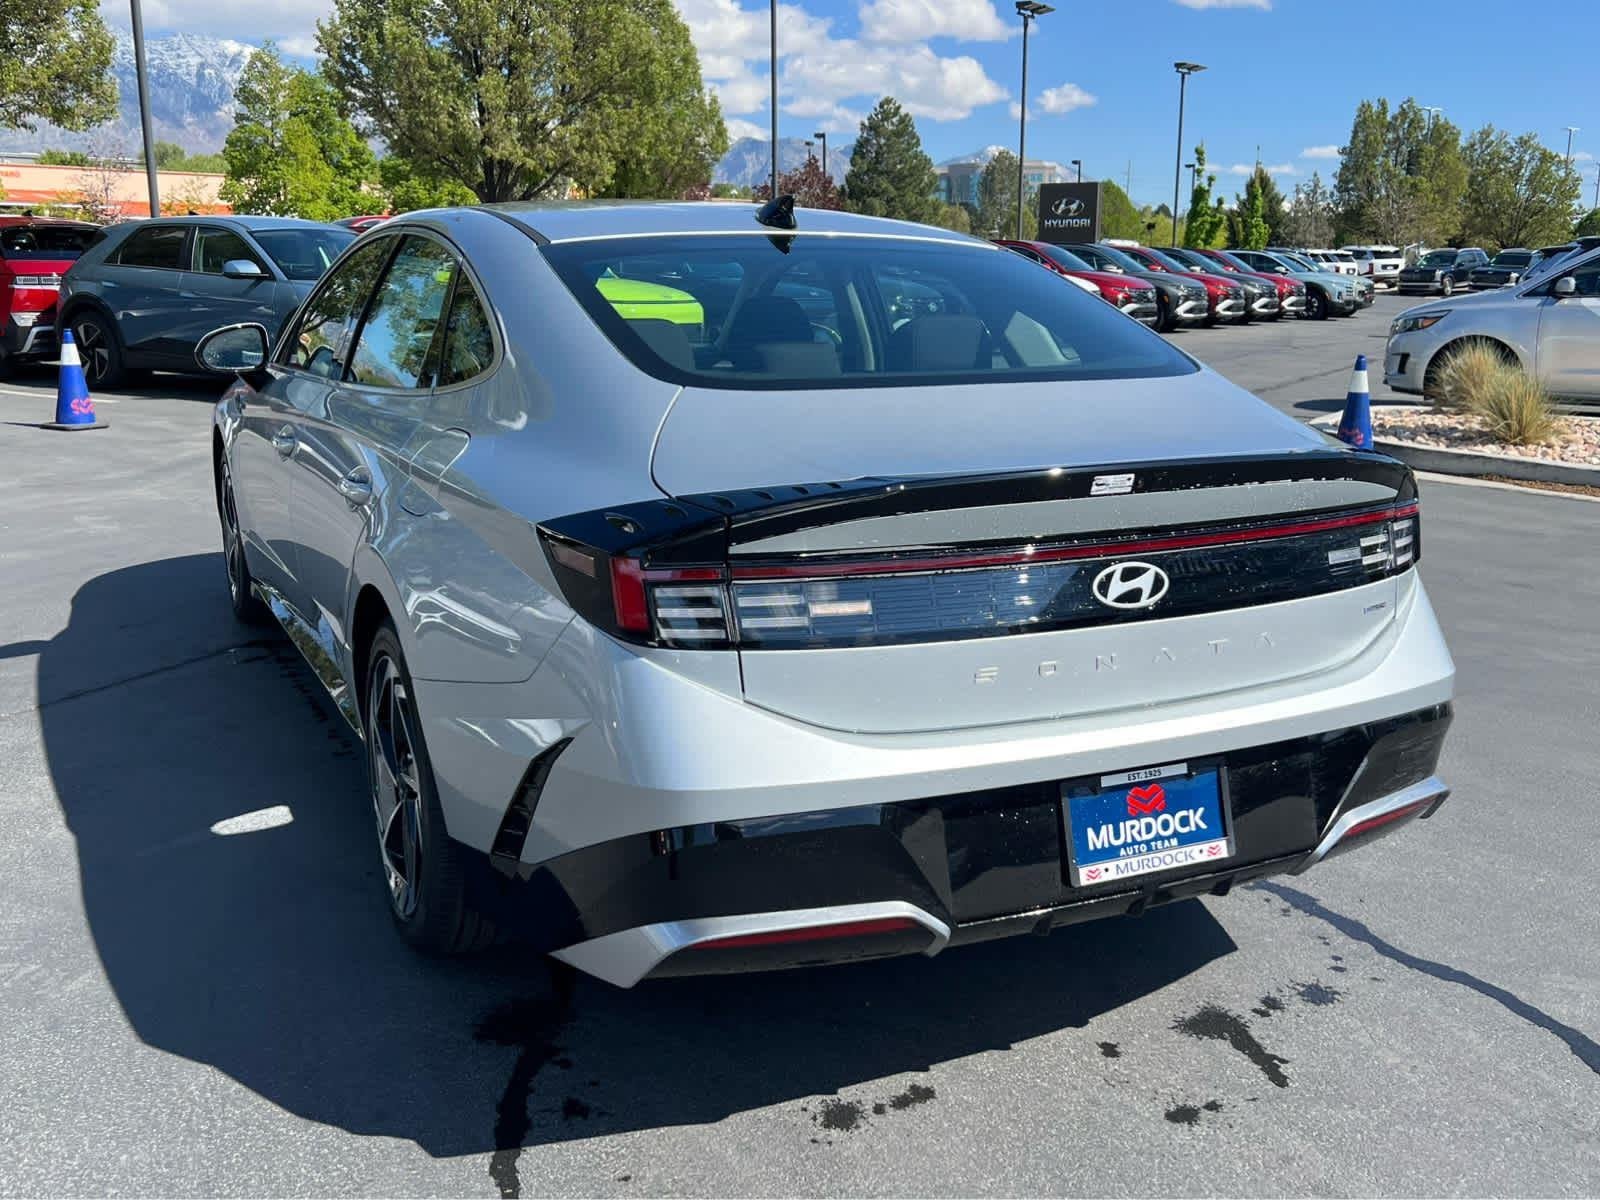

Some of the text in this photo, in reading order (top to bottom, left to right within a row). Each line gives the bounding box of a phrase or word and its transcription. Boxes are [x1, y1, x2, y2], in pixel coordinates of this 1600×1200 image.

[1044, 218, 1091, 228] HYUNDAI
[974, 631, 1276, 685] SONATA
[1127, 768, 1162, 781] EST. 1925
[1086, 807, 1208, 851] MURDOCK
[1120, 837, 1179, 856] AUTO TEAM
[1115, 849, 1196, 876] MURDOCK
